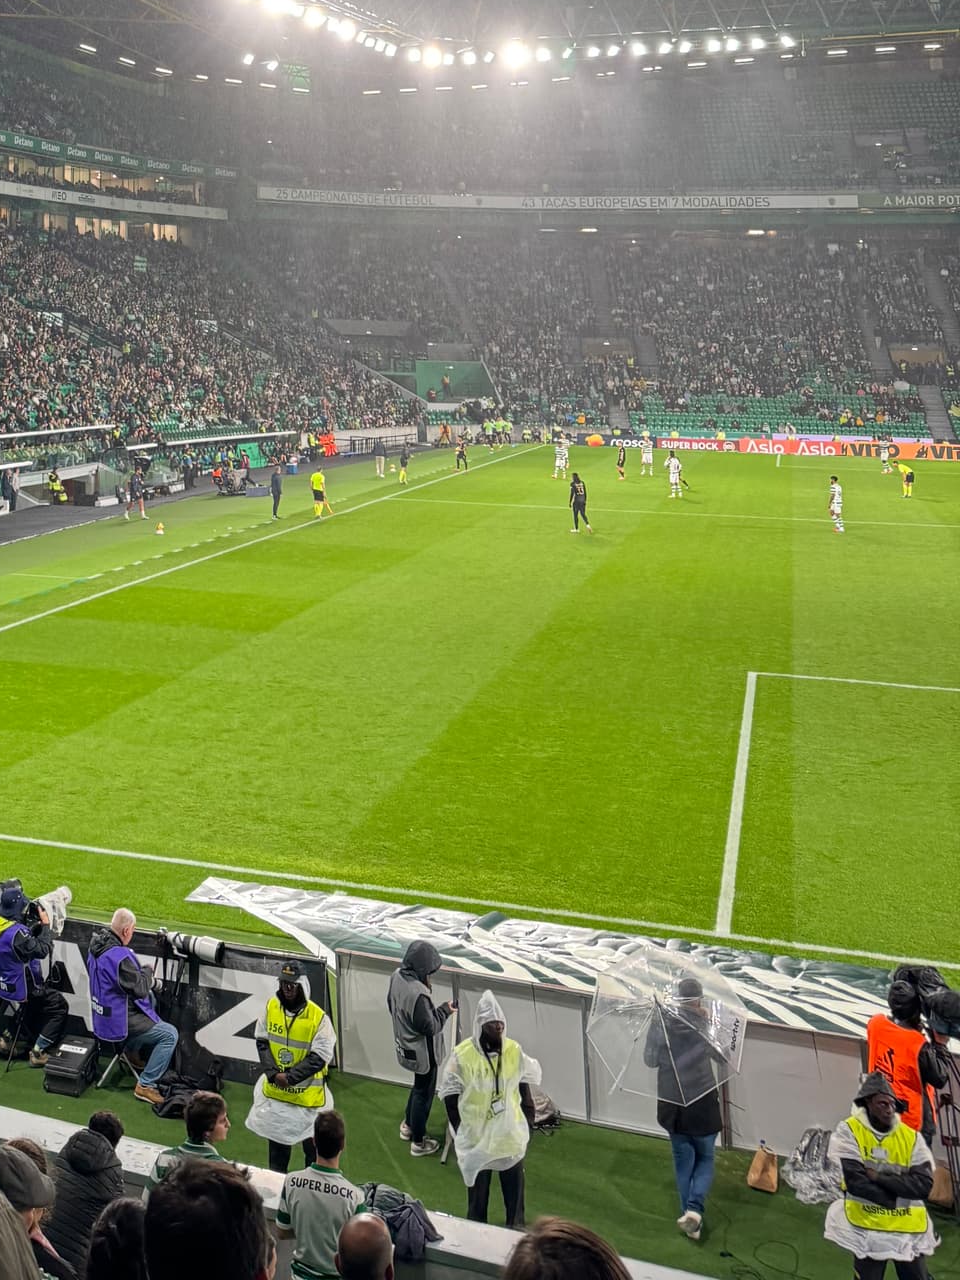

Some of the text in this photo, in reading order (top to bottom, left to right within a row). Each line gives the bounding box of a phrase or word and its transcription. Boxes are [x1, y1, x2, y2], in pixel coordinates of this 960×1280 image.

[290, 190, 364, 204] CAMPEONATOS
[580, 198, 648, 208] EUROPEIAS
[650, 198, 668, 208] EM
[682, 196, 770, 208] MODALIDADES
[884, 196, 892, 205] A
[895, 195, 935, 206] MAIOR
[662, 440, 690, 450] SUPER
[692, 441, 718, 450] BOCK
[290, 1176, 354, 1200] SUPER BOCK
